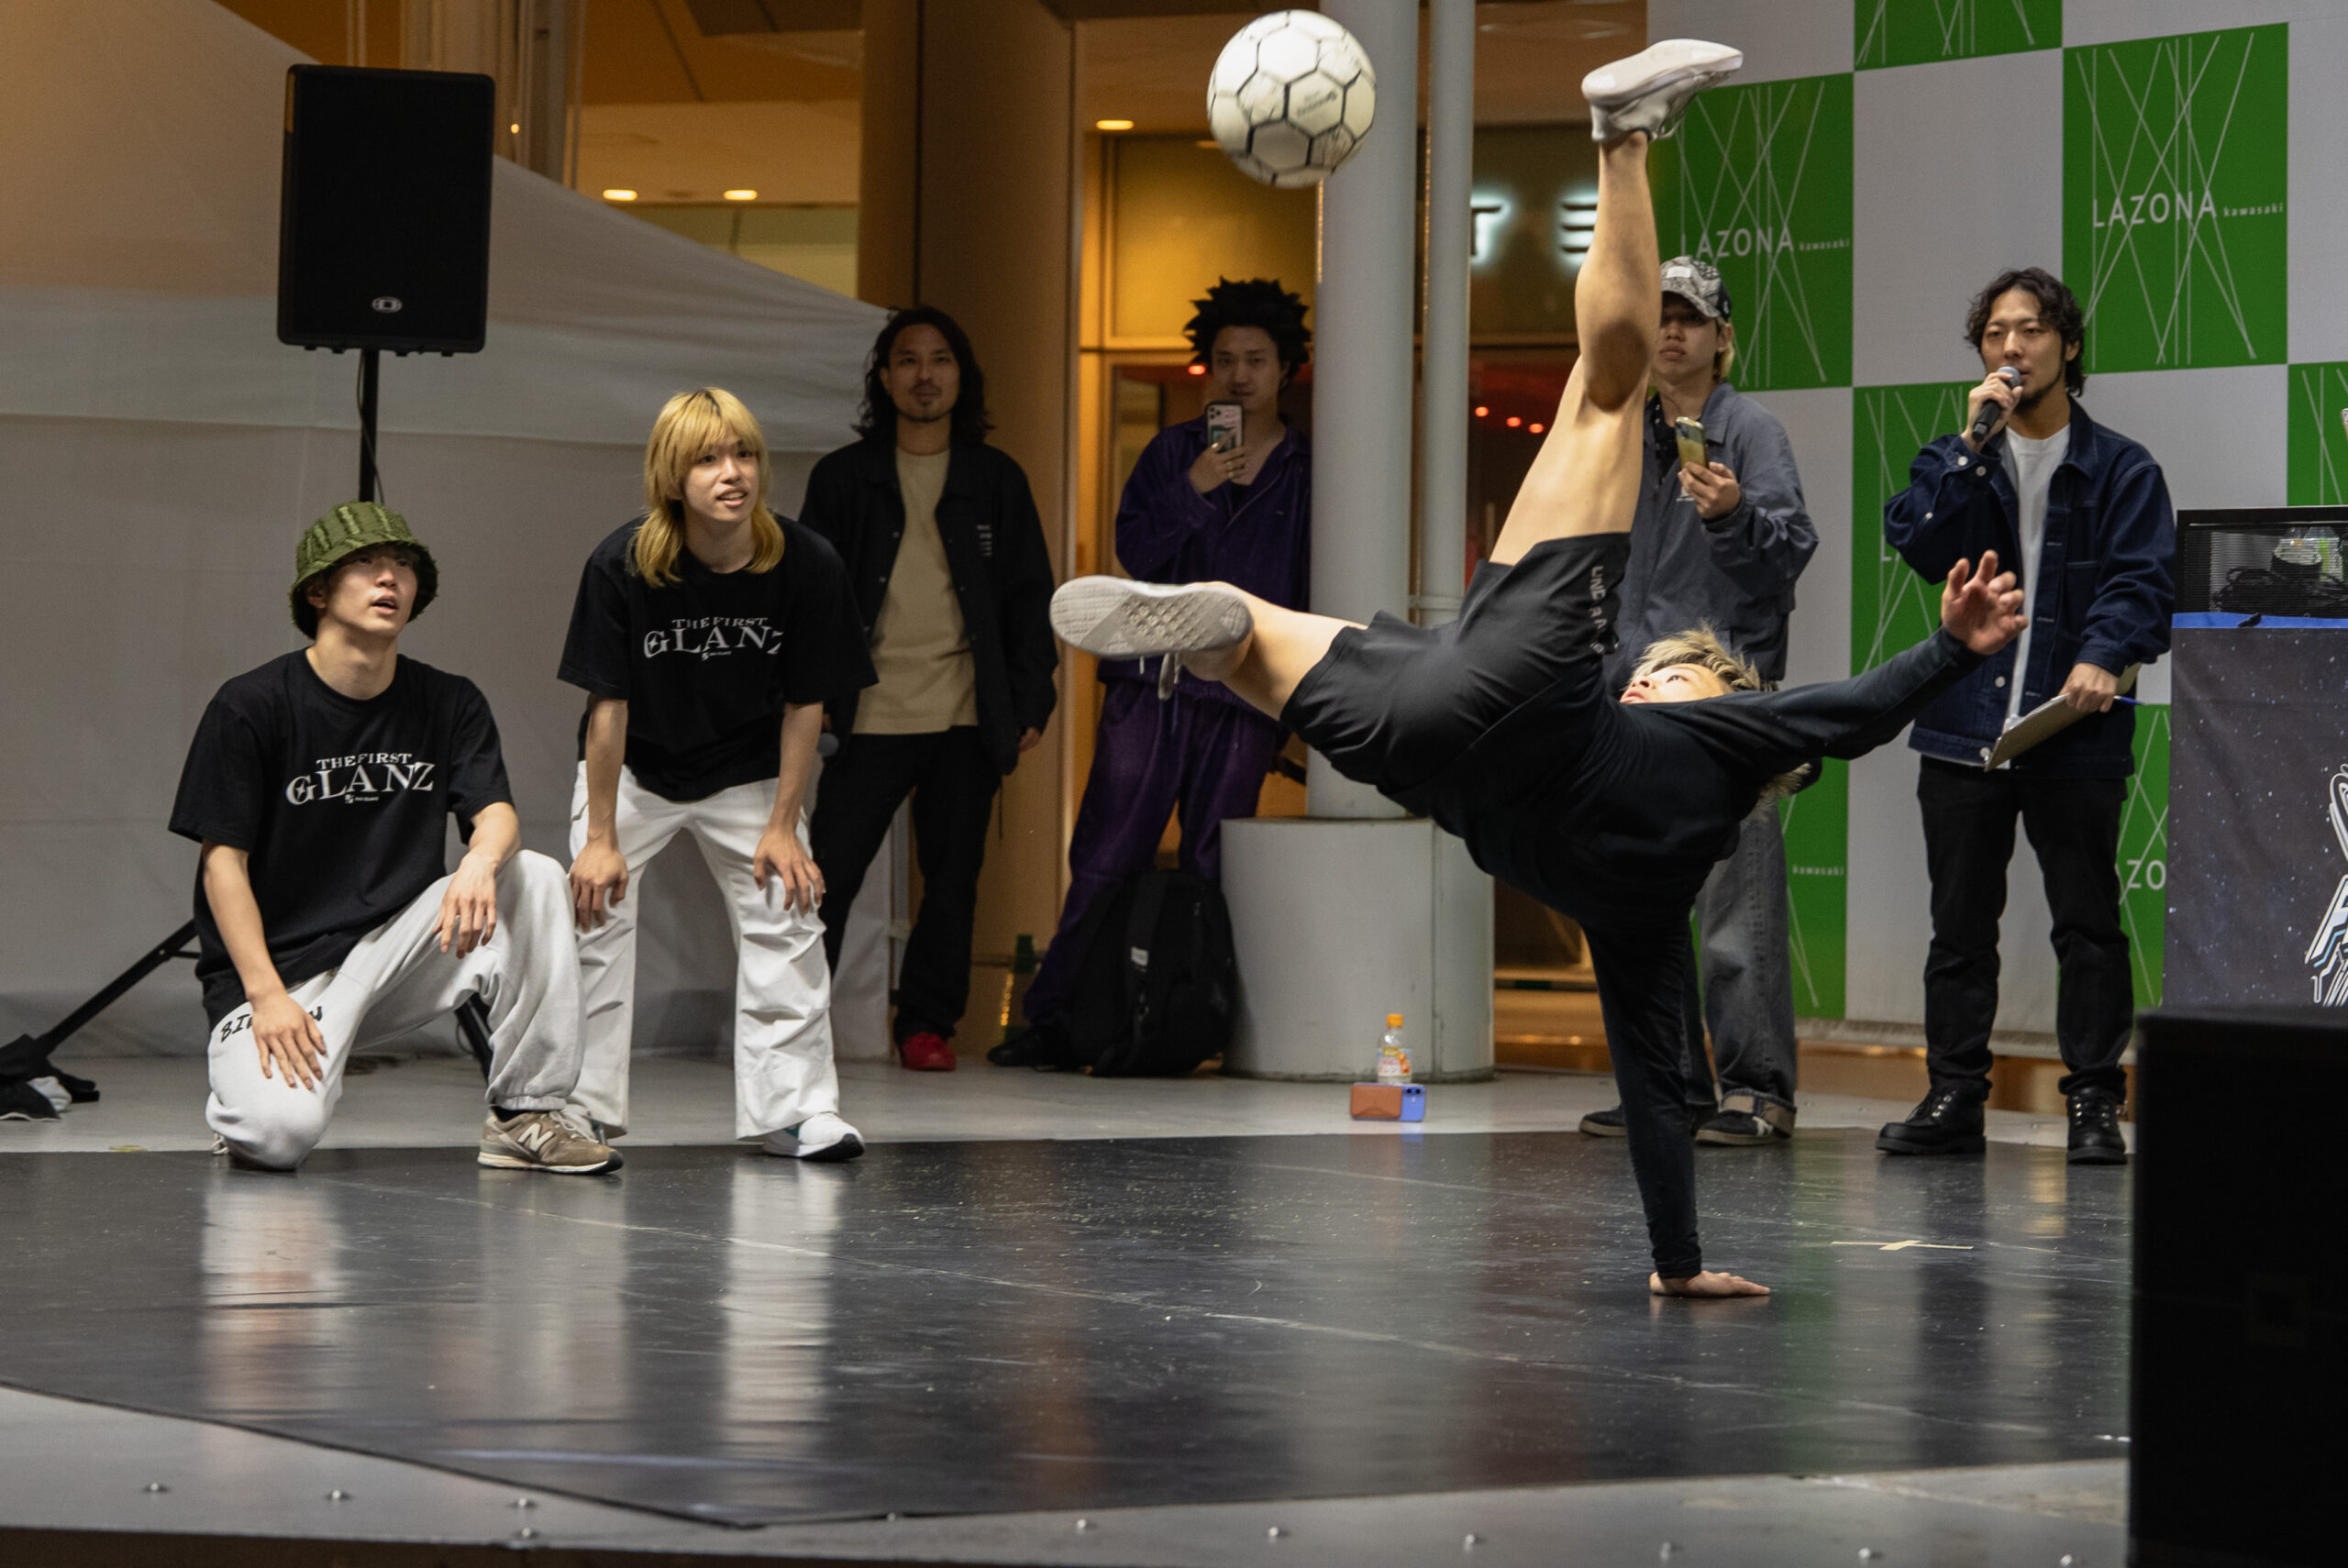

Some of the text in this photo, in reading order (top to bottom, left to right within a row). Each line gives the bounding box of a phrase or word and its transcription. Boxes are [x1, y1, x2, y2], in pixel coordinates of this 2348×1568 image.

[2092, 190, 2284, 227] LAZONA kawasaki
[1680, 227, 1851, 259] LAZONA kawasaki
[316, 752, 413, 771] THE FIRST
[285, 761, 436, 805] GLANZ
